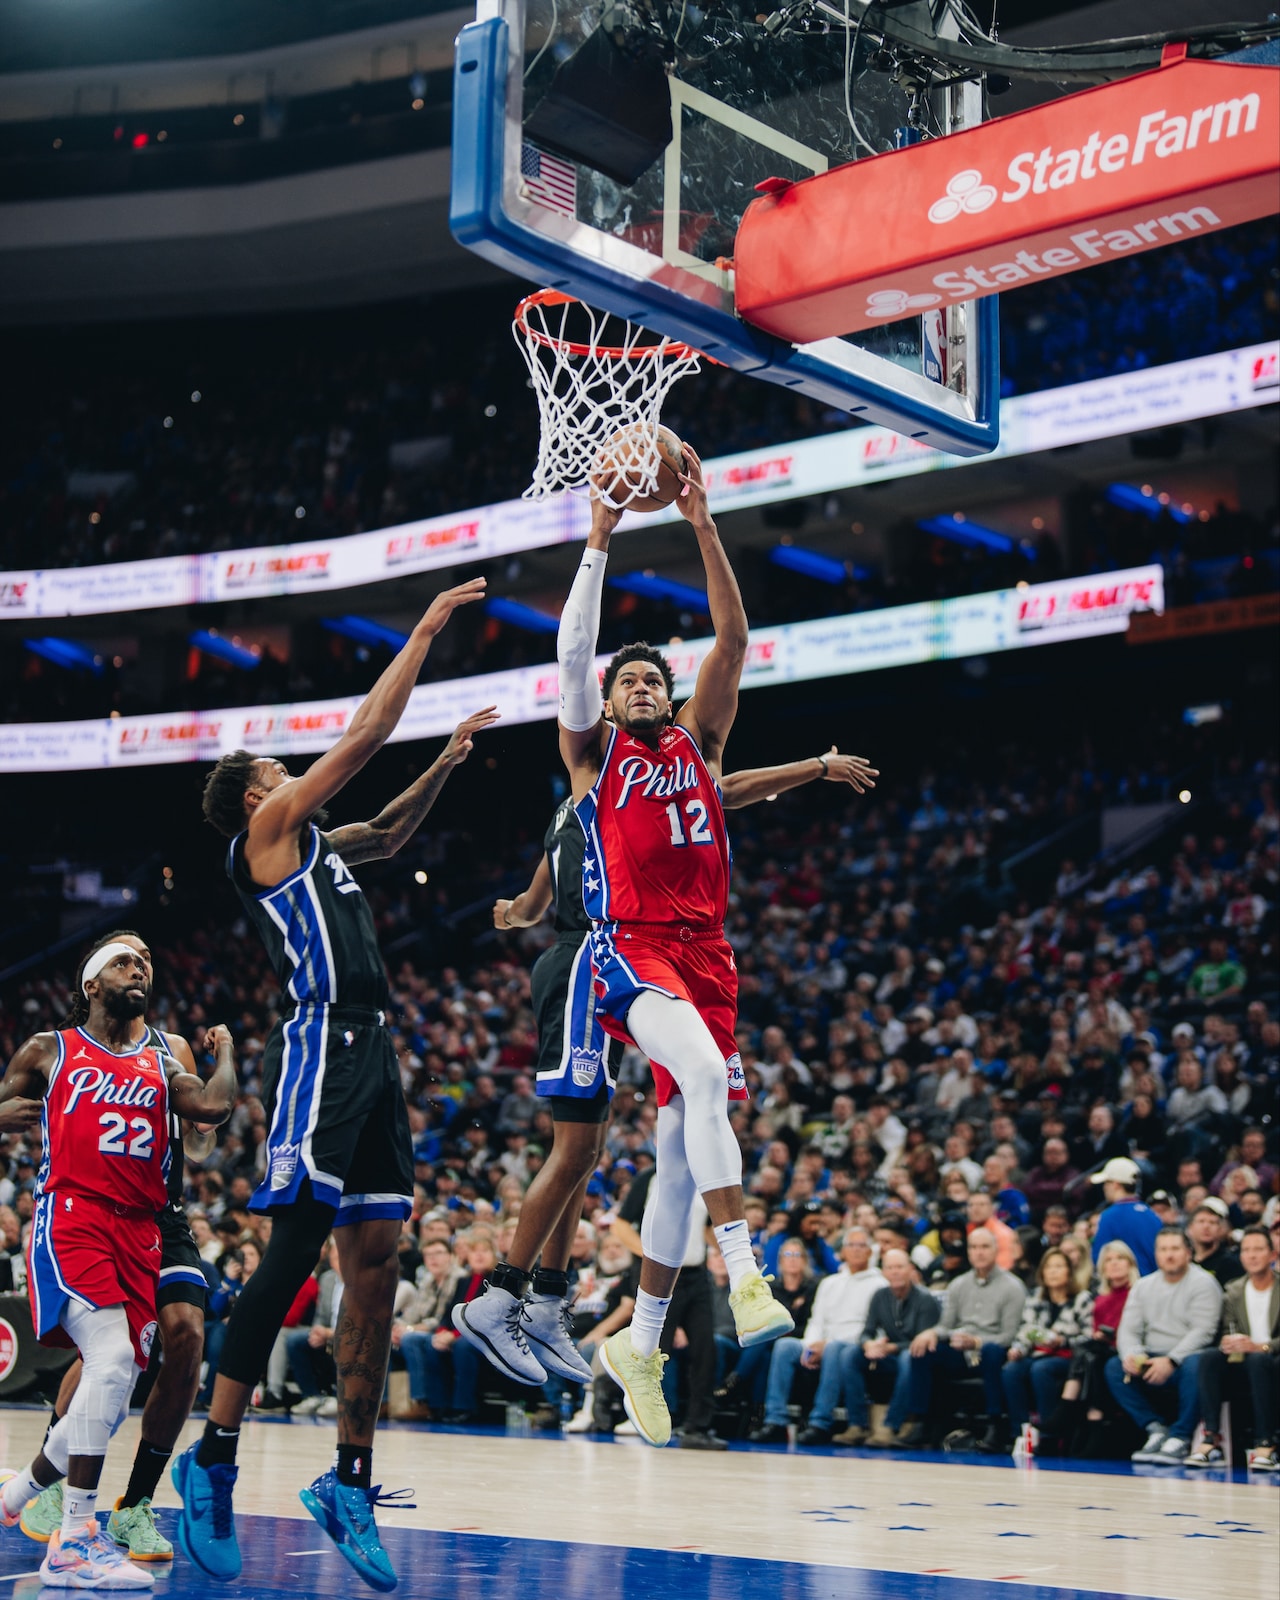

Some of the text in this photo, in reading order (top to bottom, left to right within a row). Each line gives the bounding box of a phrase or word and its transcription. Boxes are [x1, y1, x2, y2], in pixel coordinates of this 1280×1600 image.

[926, 359, 940, 380] NBA
[615, 756, 699, 809] Phila
[665, 799, 714, 848] 12
[63, 1066, 159, 1115] Phila
[98, 1111, 155, 1160] 22
